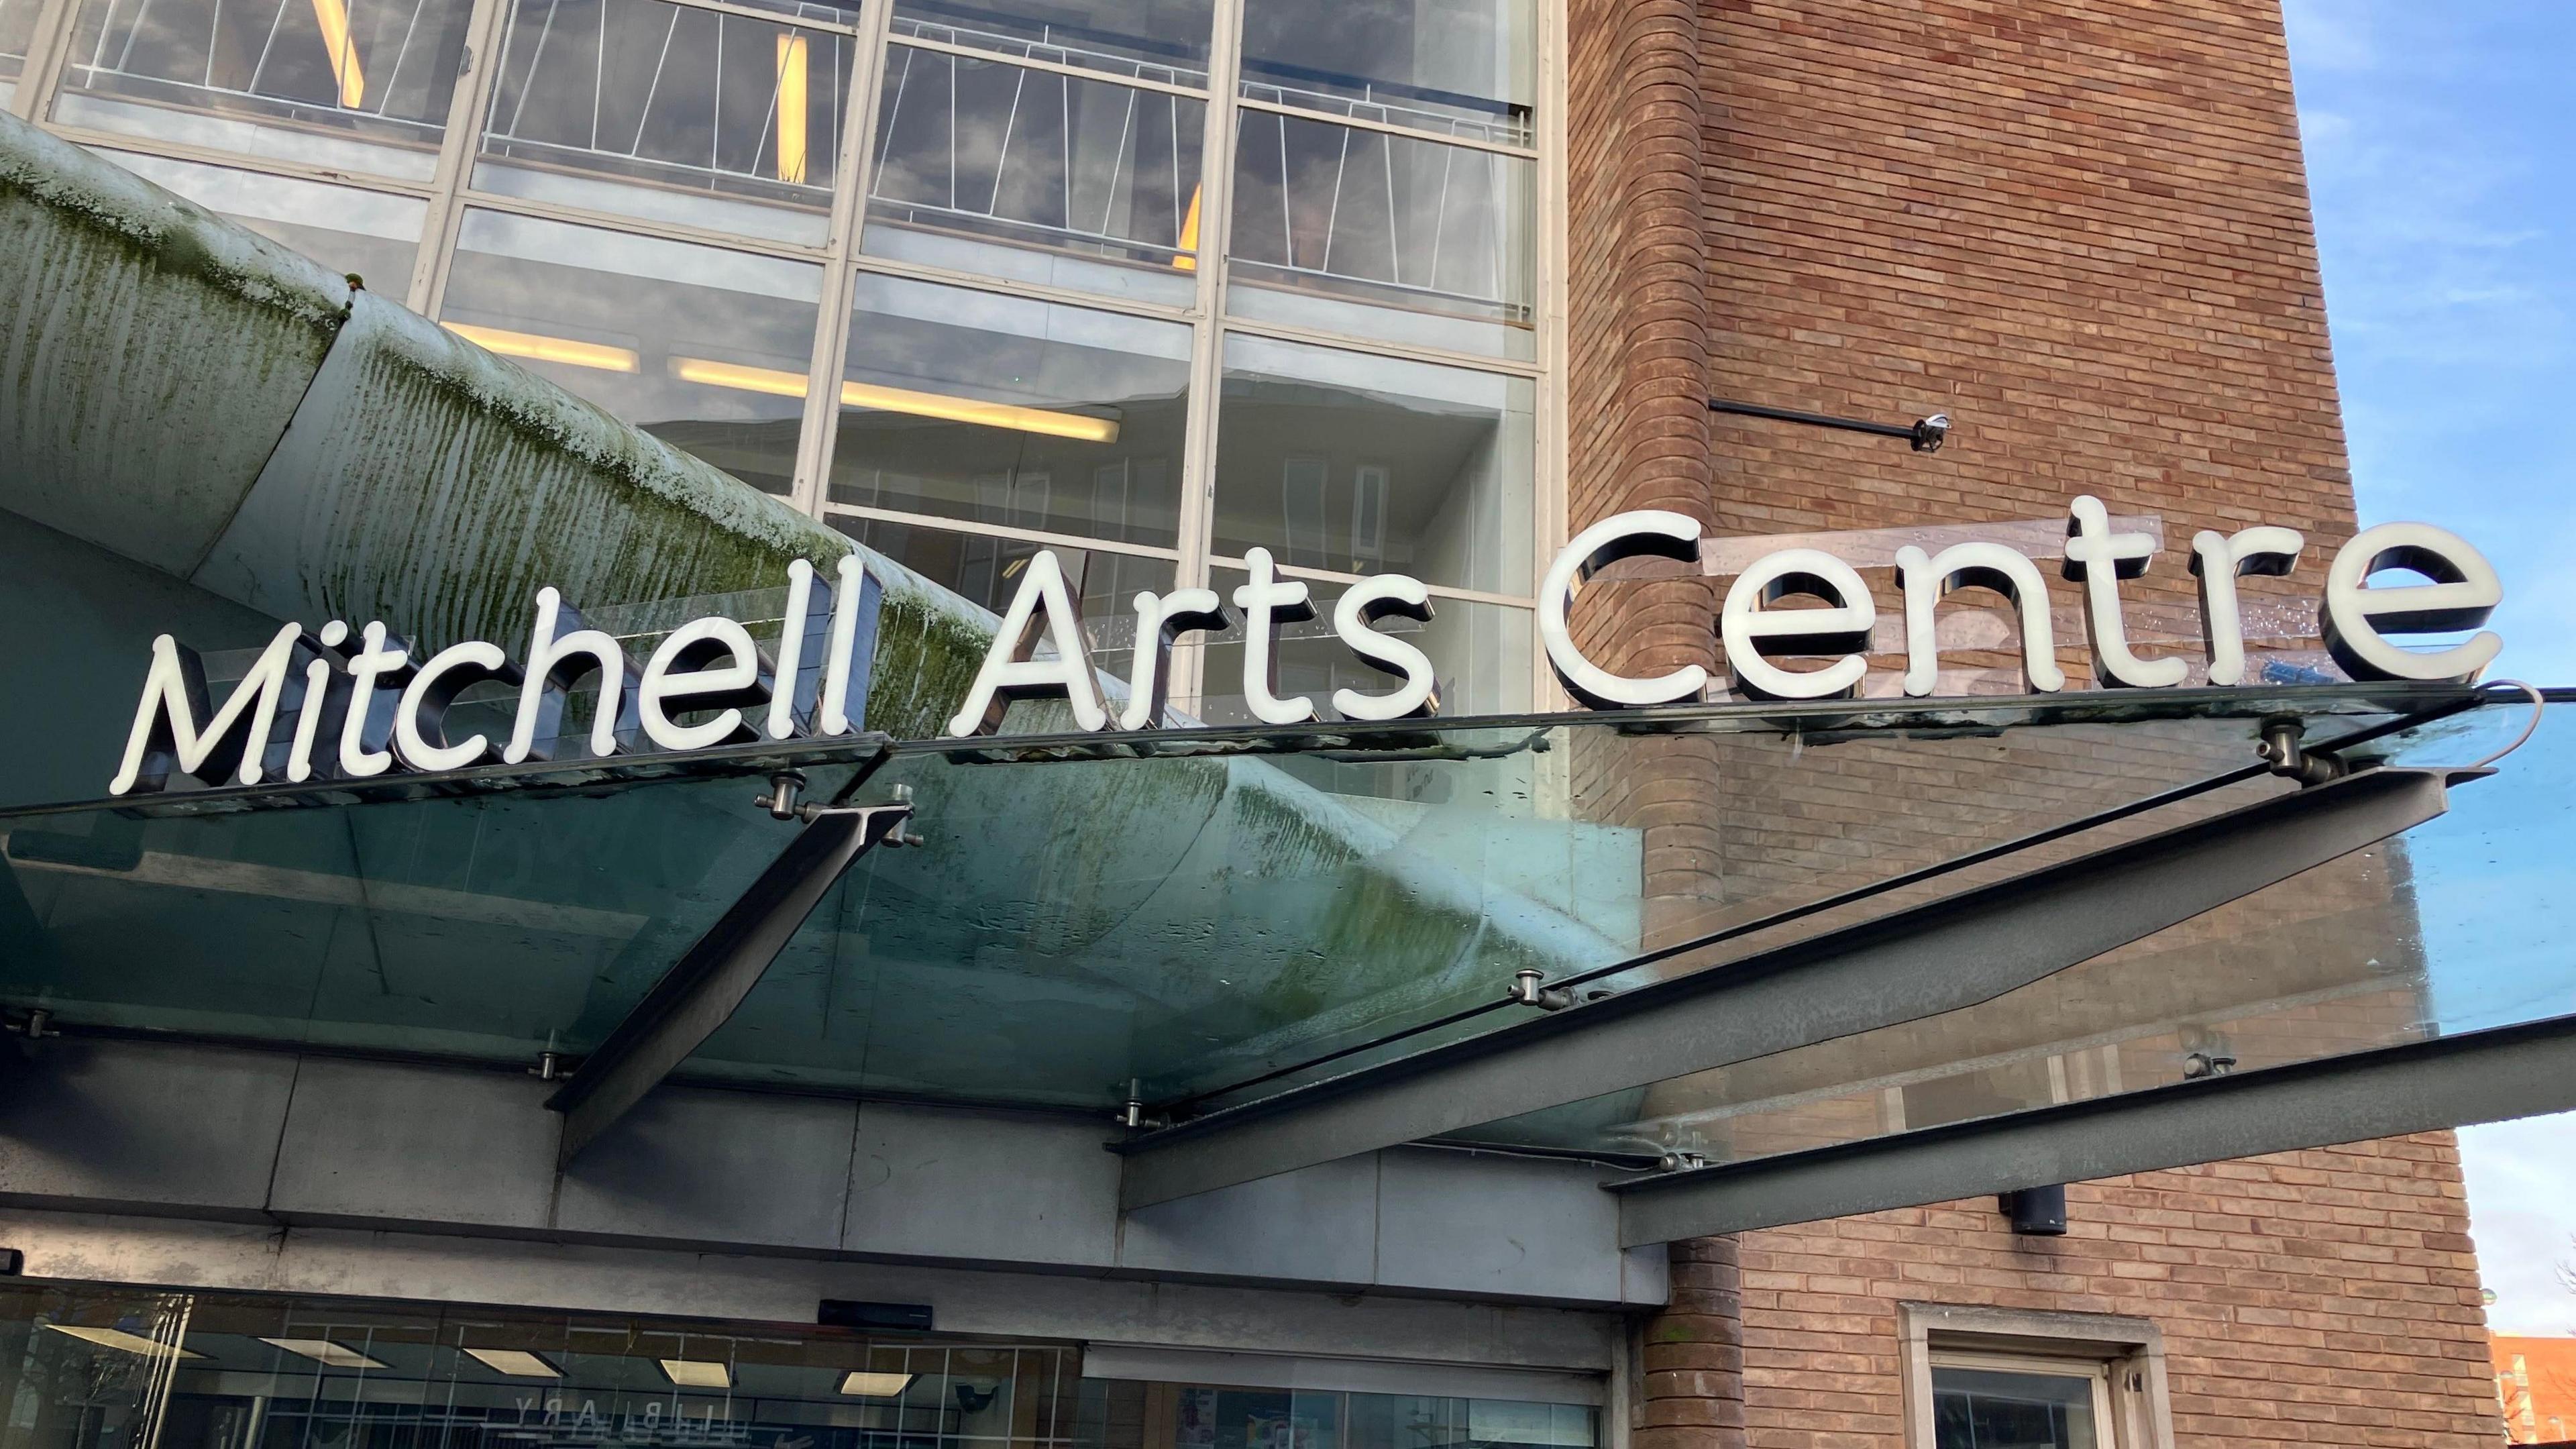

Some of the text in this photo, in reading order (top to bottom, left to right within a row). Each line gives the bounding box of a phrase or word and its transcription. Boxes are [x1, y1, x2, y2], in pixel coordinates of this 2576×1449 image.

[109, 494, 2504, 795] Mitchell Arts Centre
